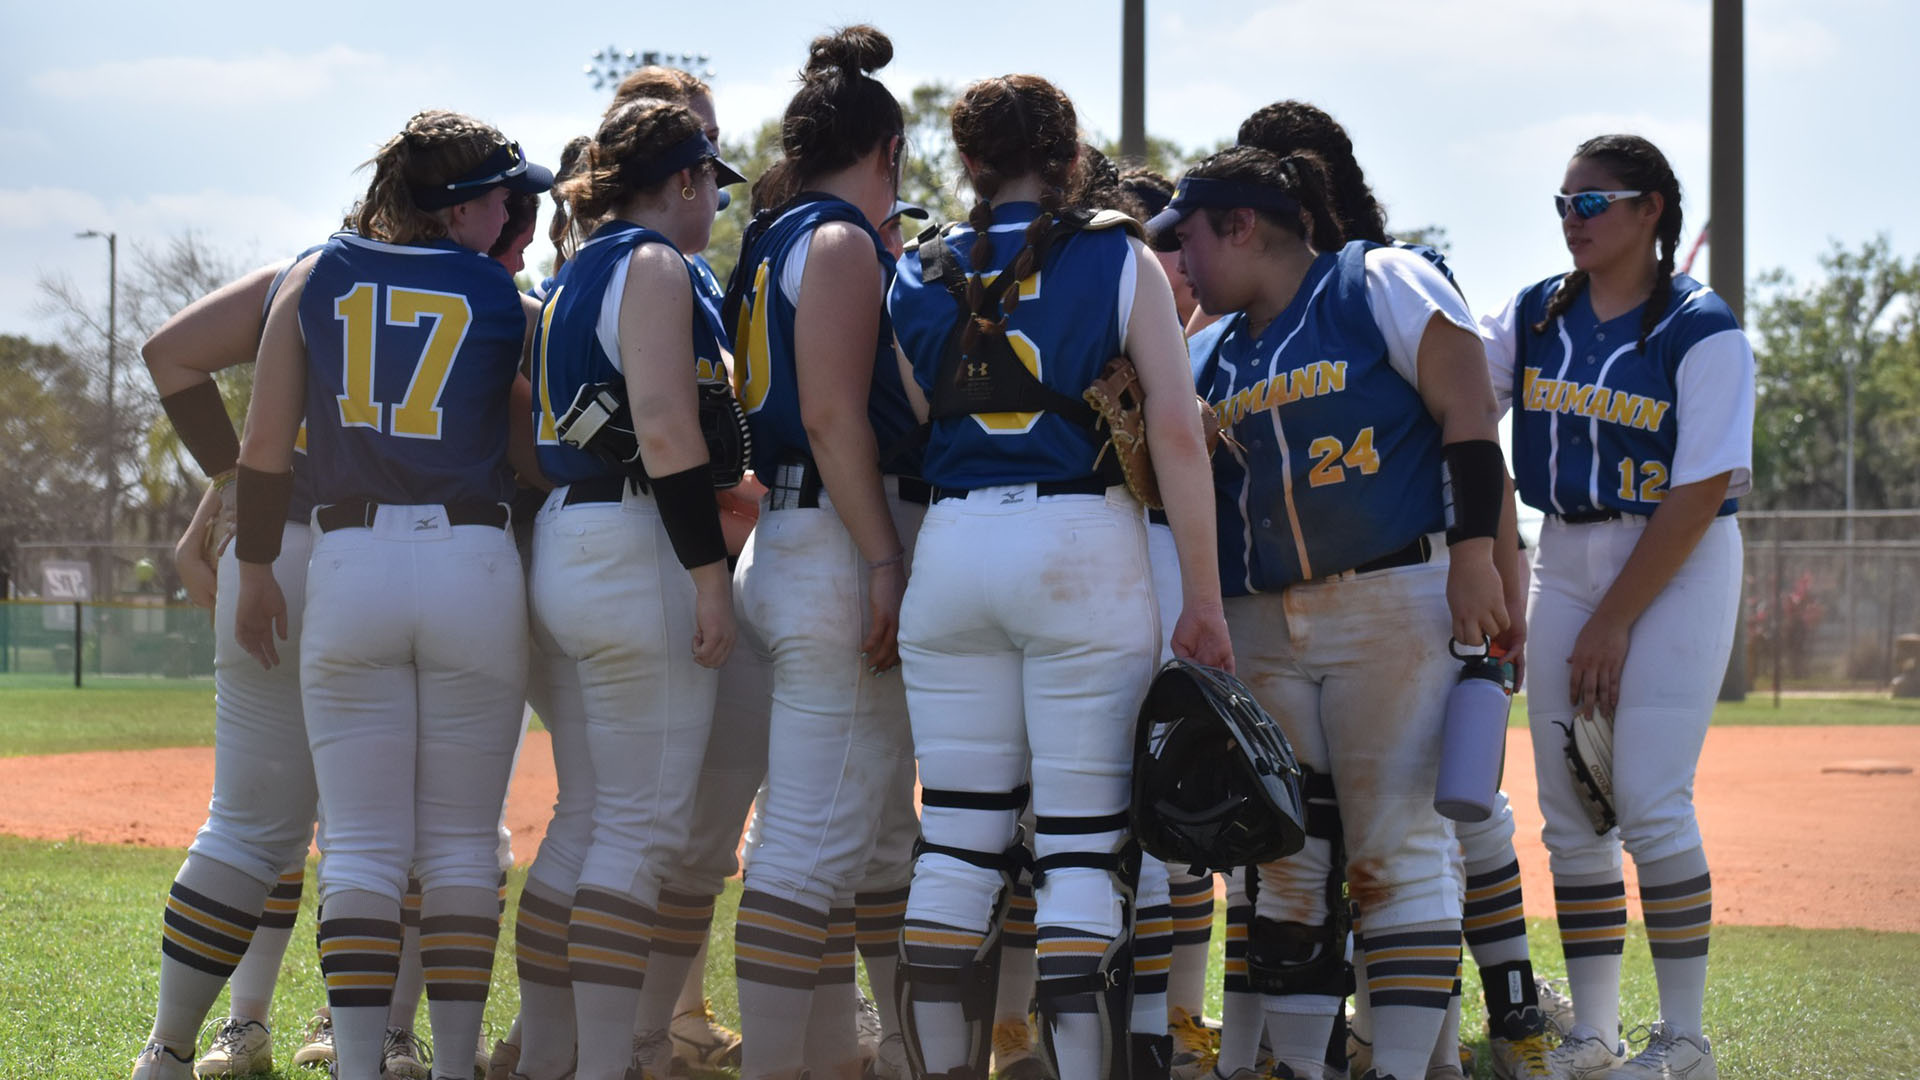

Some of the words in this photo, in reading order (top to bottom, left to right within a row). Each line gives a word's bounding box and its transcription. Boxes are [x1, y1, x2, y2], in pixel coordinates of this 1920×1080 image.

[334, 282, 473, 440] 17
[1212, 360, 1348, 429] UMANN
[1308, 426, 1380, 488] 24
[1617, 456, 1669, 503] 12
